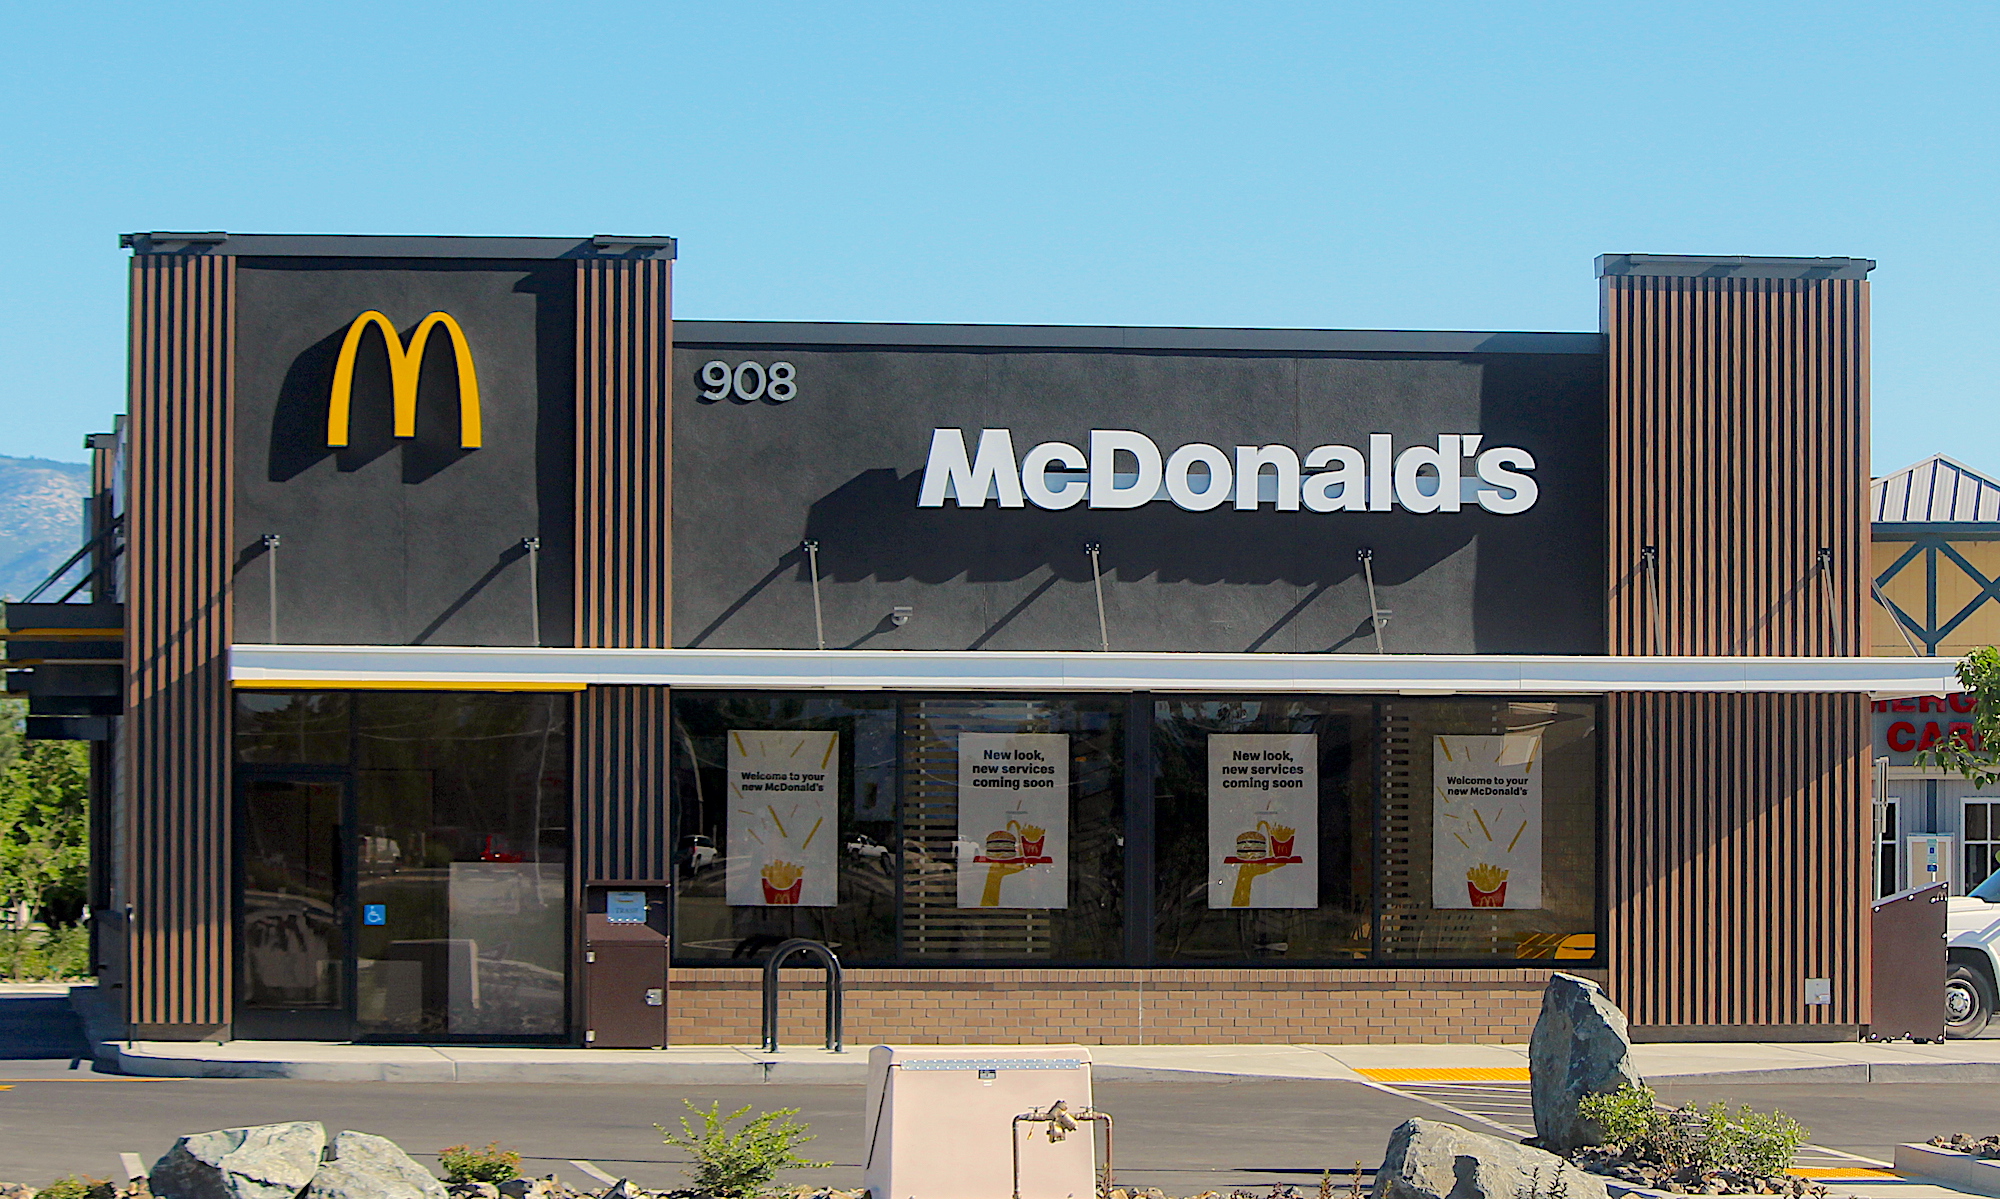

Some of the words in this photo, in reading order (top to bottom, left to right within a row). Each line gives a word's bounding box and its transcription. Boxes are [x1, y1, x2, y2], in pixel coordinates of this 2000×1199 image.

[702, 360, 798, 401] 908
[918, 428, 1539, 515] McDonald's
[1886, 721, 1989, 752] CAR
[983, 749, 1011, 760] New
[1013, 749, 1045, 762] look,
[1232, 750, 1260, 761] New
[1262, 750, 1294, 762] look,
[972, 764, 999, 774] new
[1001, 763, 1055, 774] services
[1222, 765, 1248, 775] new
[1250, 764, 1304, 775] services
[741, 771, 787, 781] Welcome
[789, 772, 800, 781] to
[801, 773, 825, 783] your
[1446, 776, 1492, 785] Welcome
[1493, 776, 1504, 785] to
[1505, 778, 1529, 788] your
[741, 783, 763, 791] new
[765, 782, 825, 792] McDonald's
[972, 777, 1020, 790] coming
[1023, 778, 1054, 788] soon
[1222, 777, 1270, 790] coming
[1272, 778, 1303, 788] soon
[1447, 788, 1468, 796] new
[1469, 786, 1528, 796] McDonald's
